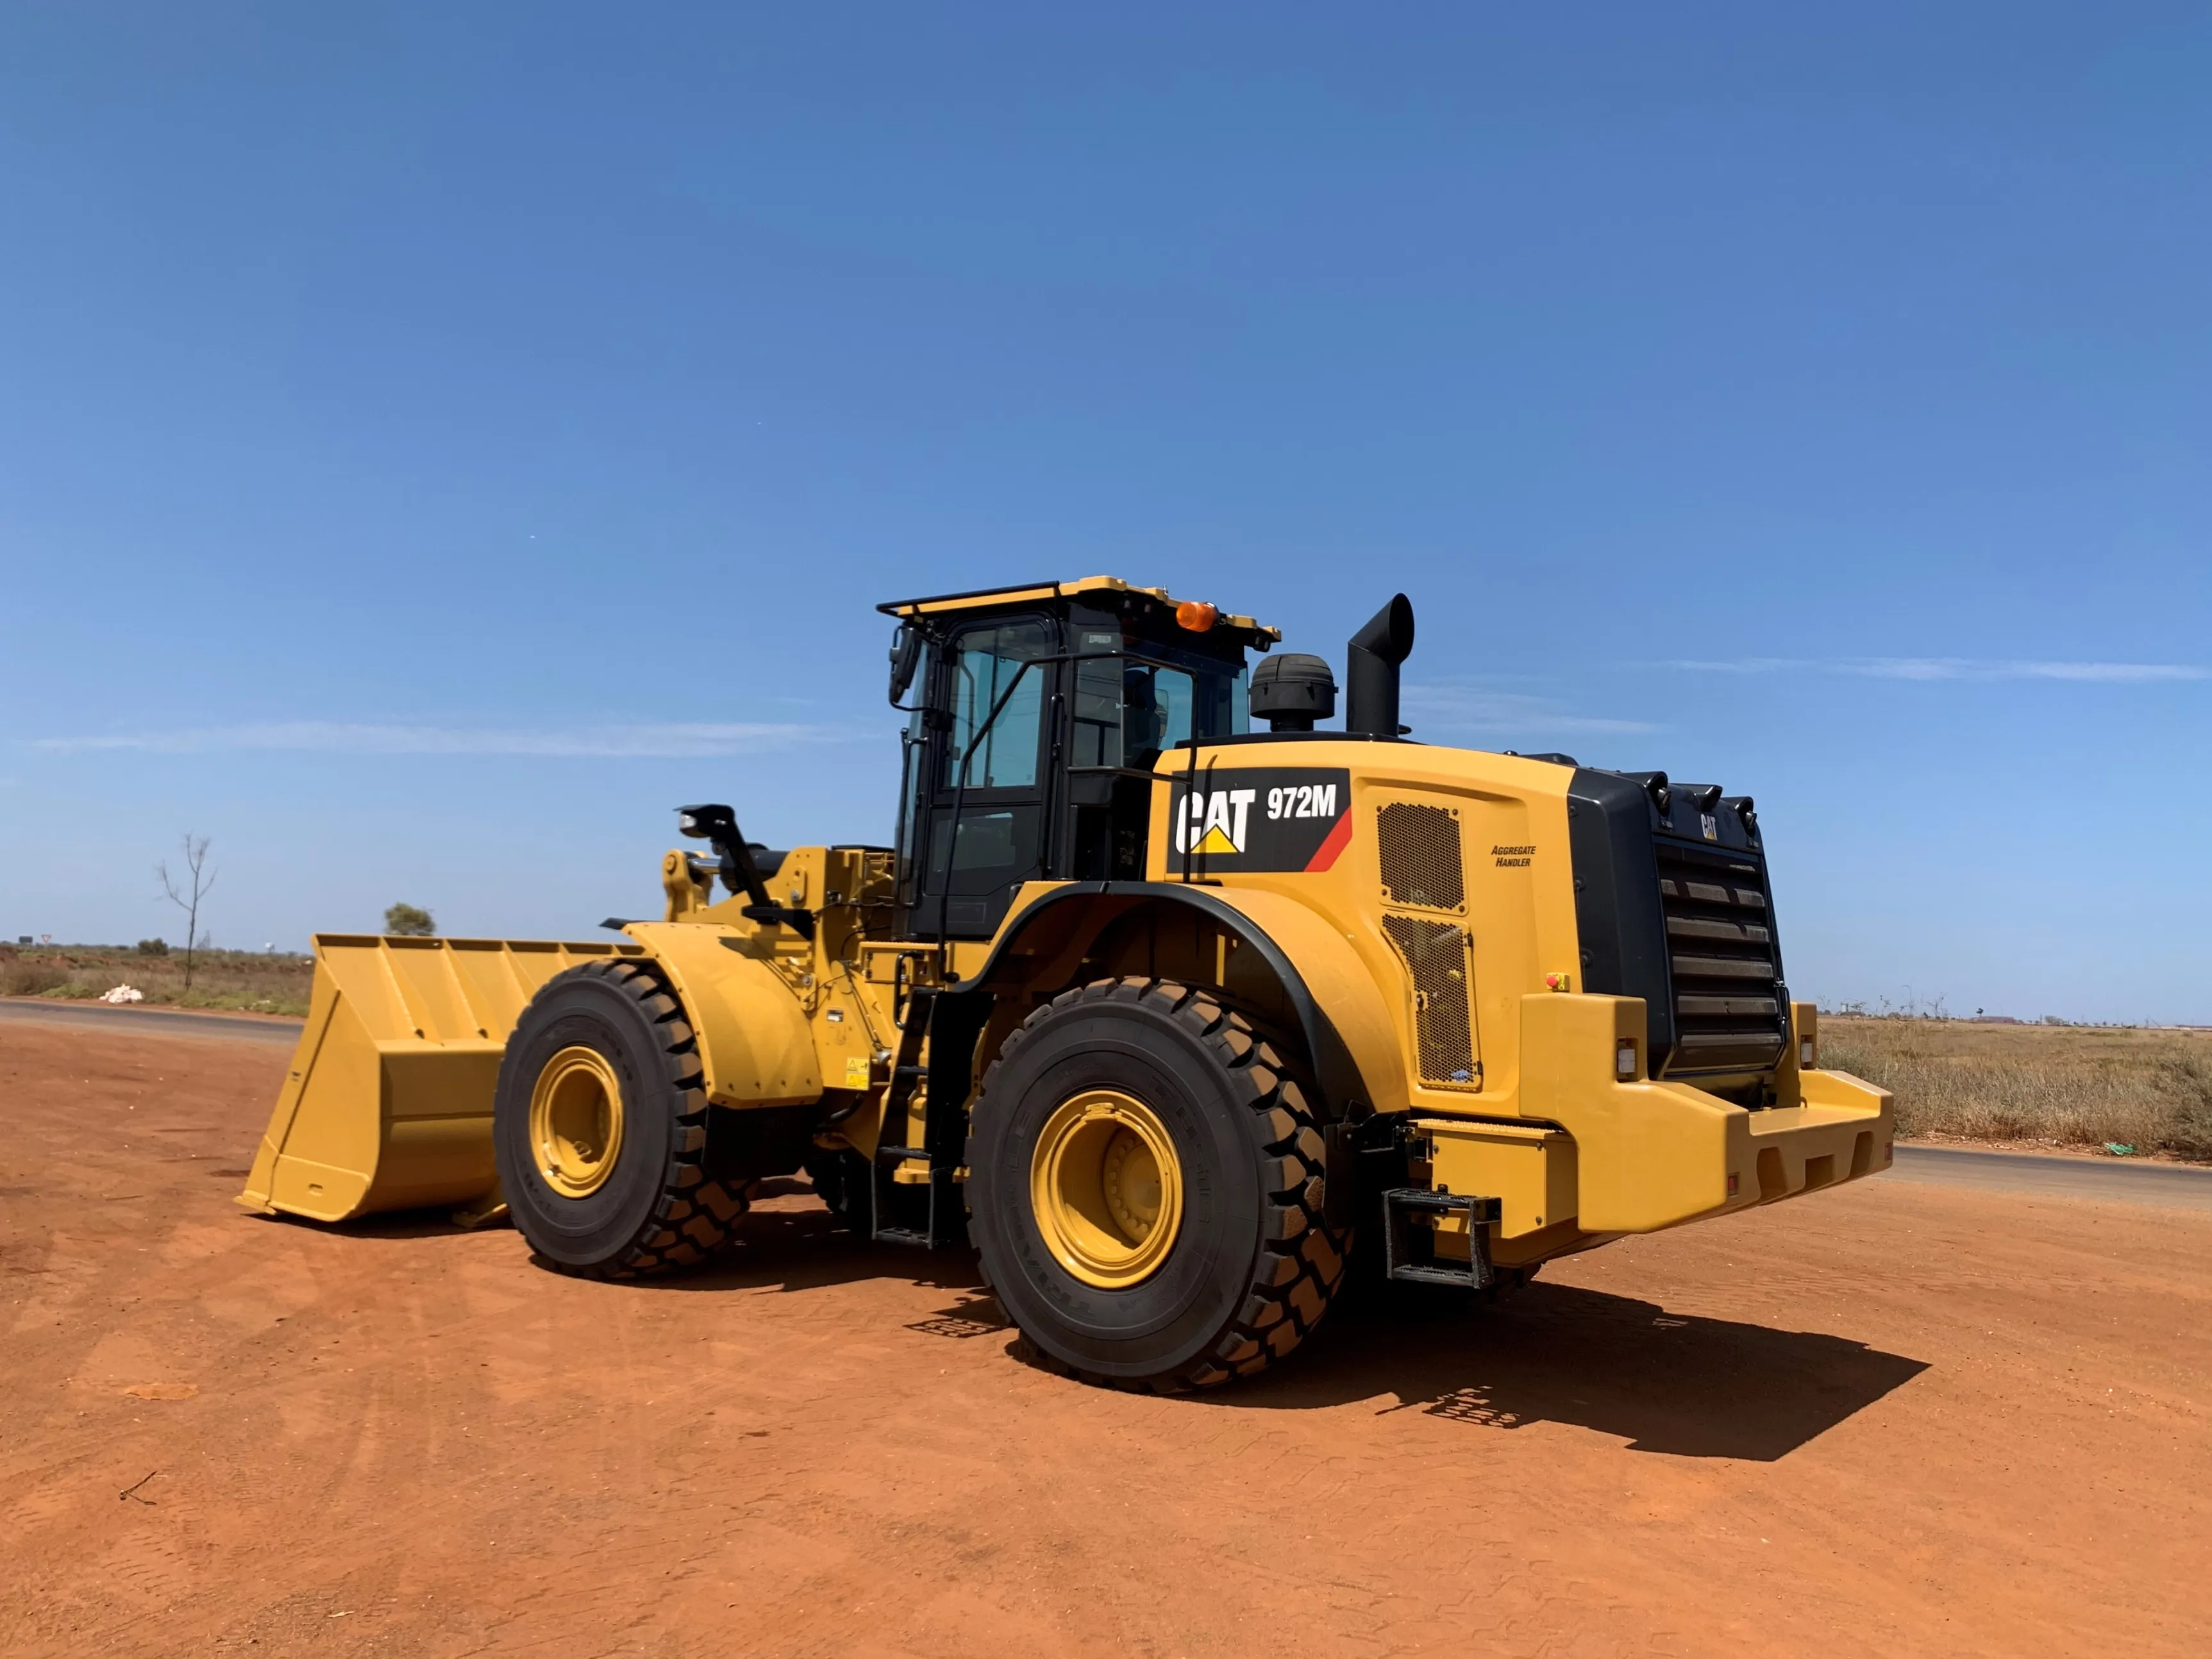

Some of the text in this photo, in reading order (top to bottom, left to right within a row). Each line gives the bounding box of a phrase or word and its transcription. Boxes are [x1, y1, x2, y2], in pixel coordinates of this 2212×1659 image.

[1176, 784, 1336, 854] CAT 972M
[1701, 813, 1718, 841] CAT
[1491, 845, 1537, 855] AGGREGATE
[1495, 857, 1530, 867] HANDLER
